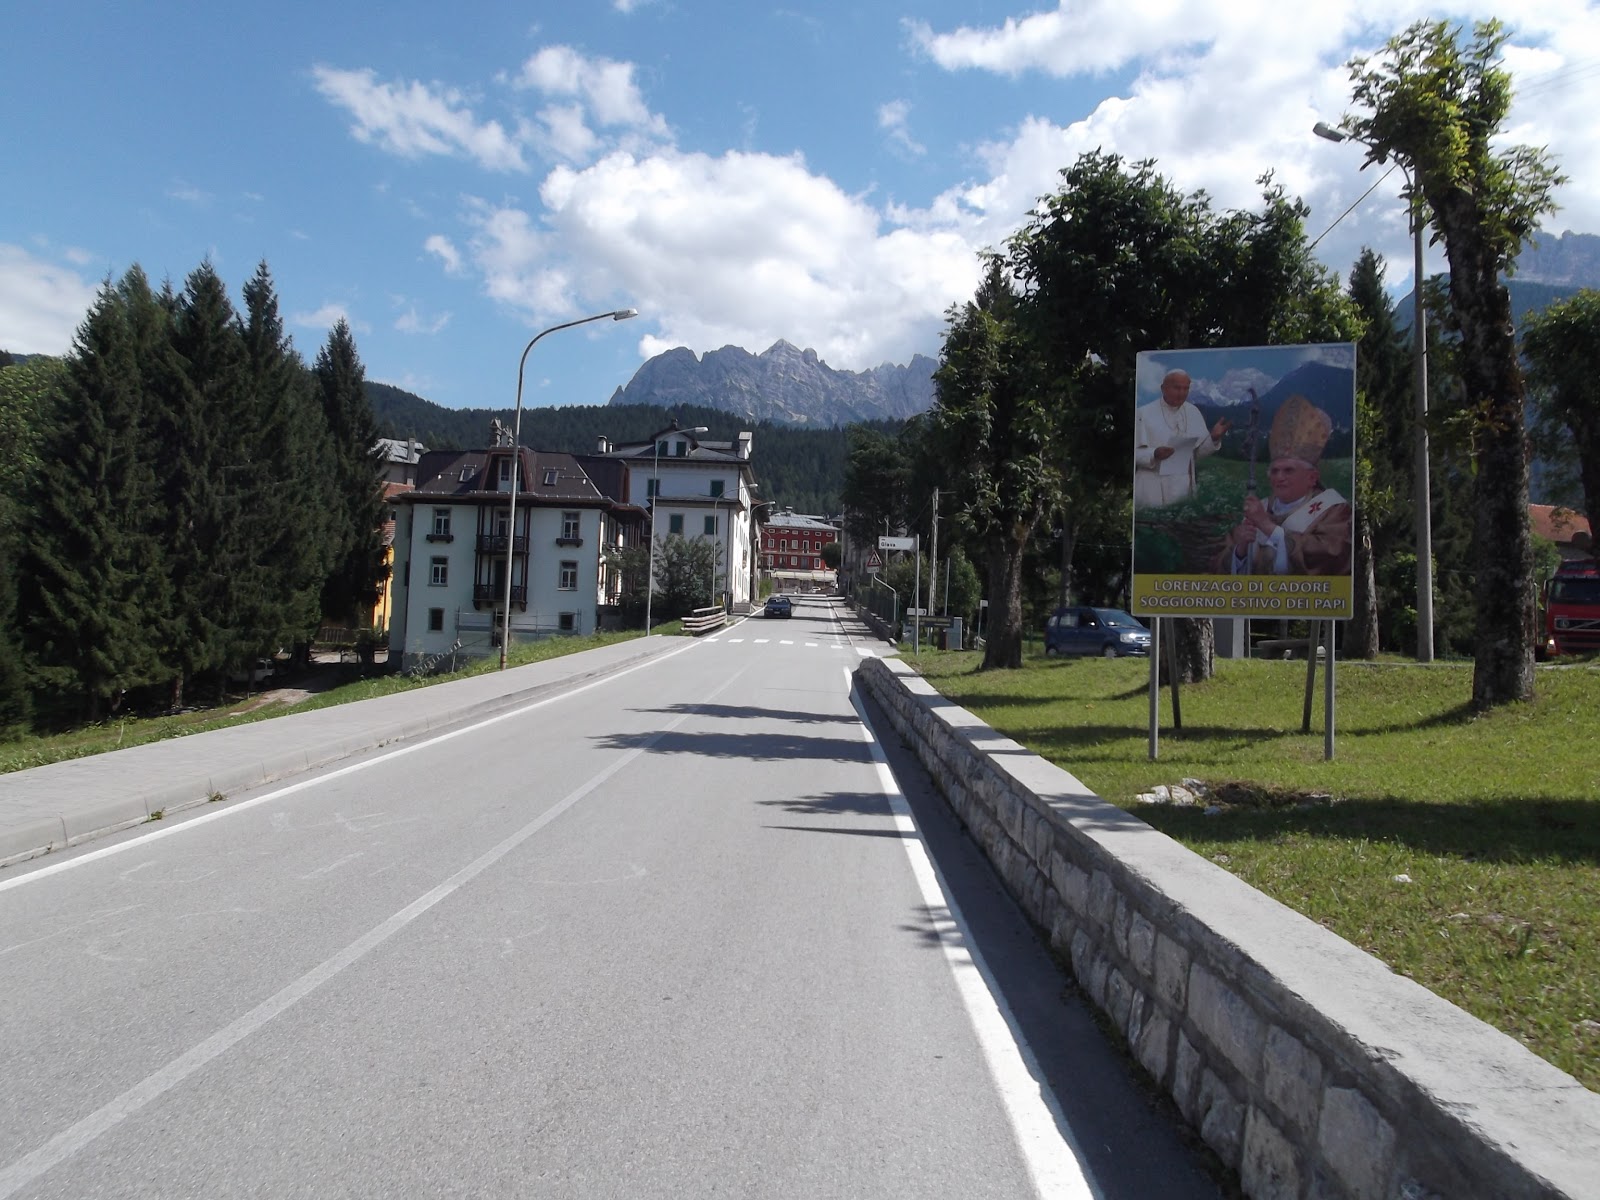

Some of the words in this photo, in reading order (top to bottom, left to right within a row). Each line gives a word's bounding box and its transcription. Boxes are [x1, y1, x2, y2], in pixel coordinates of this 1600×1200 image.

[1154, 580, 1243, 592] LORENZAGO
[1248, 581, 1263, 592] DI
[1268, 581, 1330, 593] CADORE
[1140, 596, 1226, 608] SOGGIORNO
[1231, 597, 1281, 609] ESTIVO
[1286, 598, 1309, 609] DEI
[1314, 598, 1346, 609] PAPI
